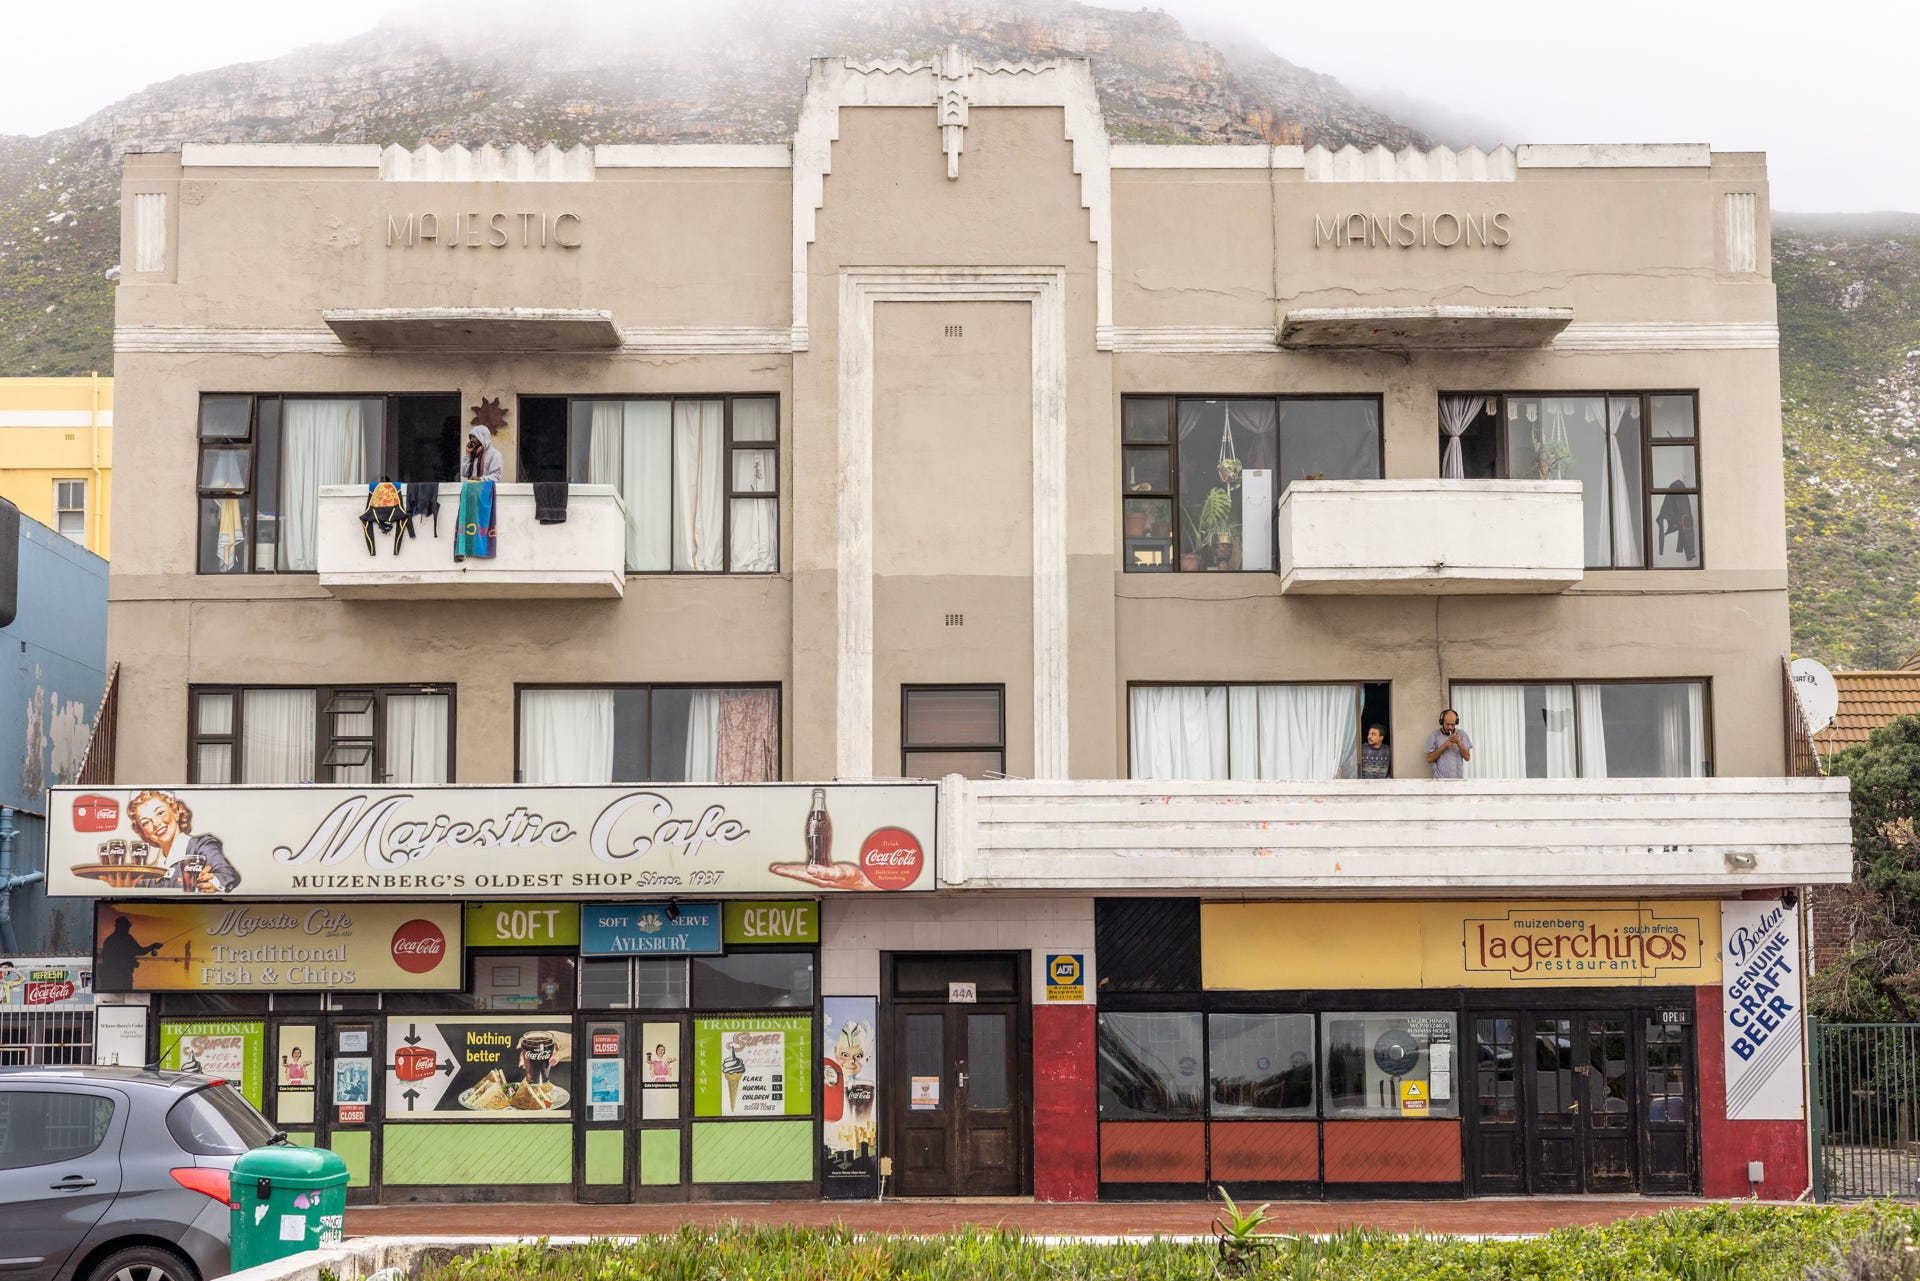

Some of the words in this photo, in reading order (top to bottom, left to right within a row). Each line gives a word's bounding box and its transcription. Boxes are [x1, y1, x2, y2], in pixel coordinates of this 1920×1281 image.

[386, 211, 582, 249] MAJESTIC
[1314, 211, 1512, 249] MANSIONS
[272, 793, 577, 871] Majestic
[589, 791, 751, 864] Cafe
[865, 848, 917, 866] Coca-Cola
[291, 874, 466, 889] MUIZENBERG'S
[475, 873, 562, 888] OLDEST
[572, 873, 632, 887] SHOP
[637, 870, 683, 888] Since
[690, 870, 726, 887] 1937
[206, 907, 300, 938] Majestic
[303, 907, 353, 936] Cafe
[496, 909, 561, 940] SOFT
[599, 917, 629, 928] SOFT
[671, 916, 710, 927] SERVE
[743, 908, 809, 938] SERVE
[1514, 917, 1584, 932] muizenberg
[1624, 923, 1652, 935] south
[1652, 922, 1680, 935] africa
[611, 932, 691, 952] AYLESBURY
[1728, 906, 1783, 967] Boston
[211, 943, 348, 964] Traditional
[393, 937, 445, 956] Coca-Cola
[1477, 923, 1688, 973] lagerchinos
[1057, 965, 1074, 975] ADT
[1536, 958, 1639, 970] restaurant
[1728, 931, 1790, 1000] GENUINE
[32, 970, 63, 980] REFRESH
[201, 966, 253, 986] Fish
[260, 967, 280, 985] &
[285, 965, 357, 989] Chips
[30, 984, 69, 1002] Coca-Cola
[952, 989, 973, 999] 44A
[1729, 954, 1793, 1028] CRAFT
[700, 1019, 804, 1031] TRADITIONAL
[1662, 1011, 1686, 1023] OPEN
[165, 1024, 259, 1035] TRADITIONAL
[1730, 994, 1795, 1062] BEER
[184, 1036, 242, 1057] SUPER
[466, 1030, 512, 1049] Nothing
[594, 1043, 618, 1053] CLOSED
[725, 1032, 782, 1053] SUPER
[210, 1052, 232, 1061] ICE
[466, 1049, 501, 1063] better
[203, 1063, 241, 1071] CREAM
[742, 1093, 770, 1101] CHILDREN
[340, 1111, 364, 1121] CLOSED
